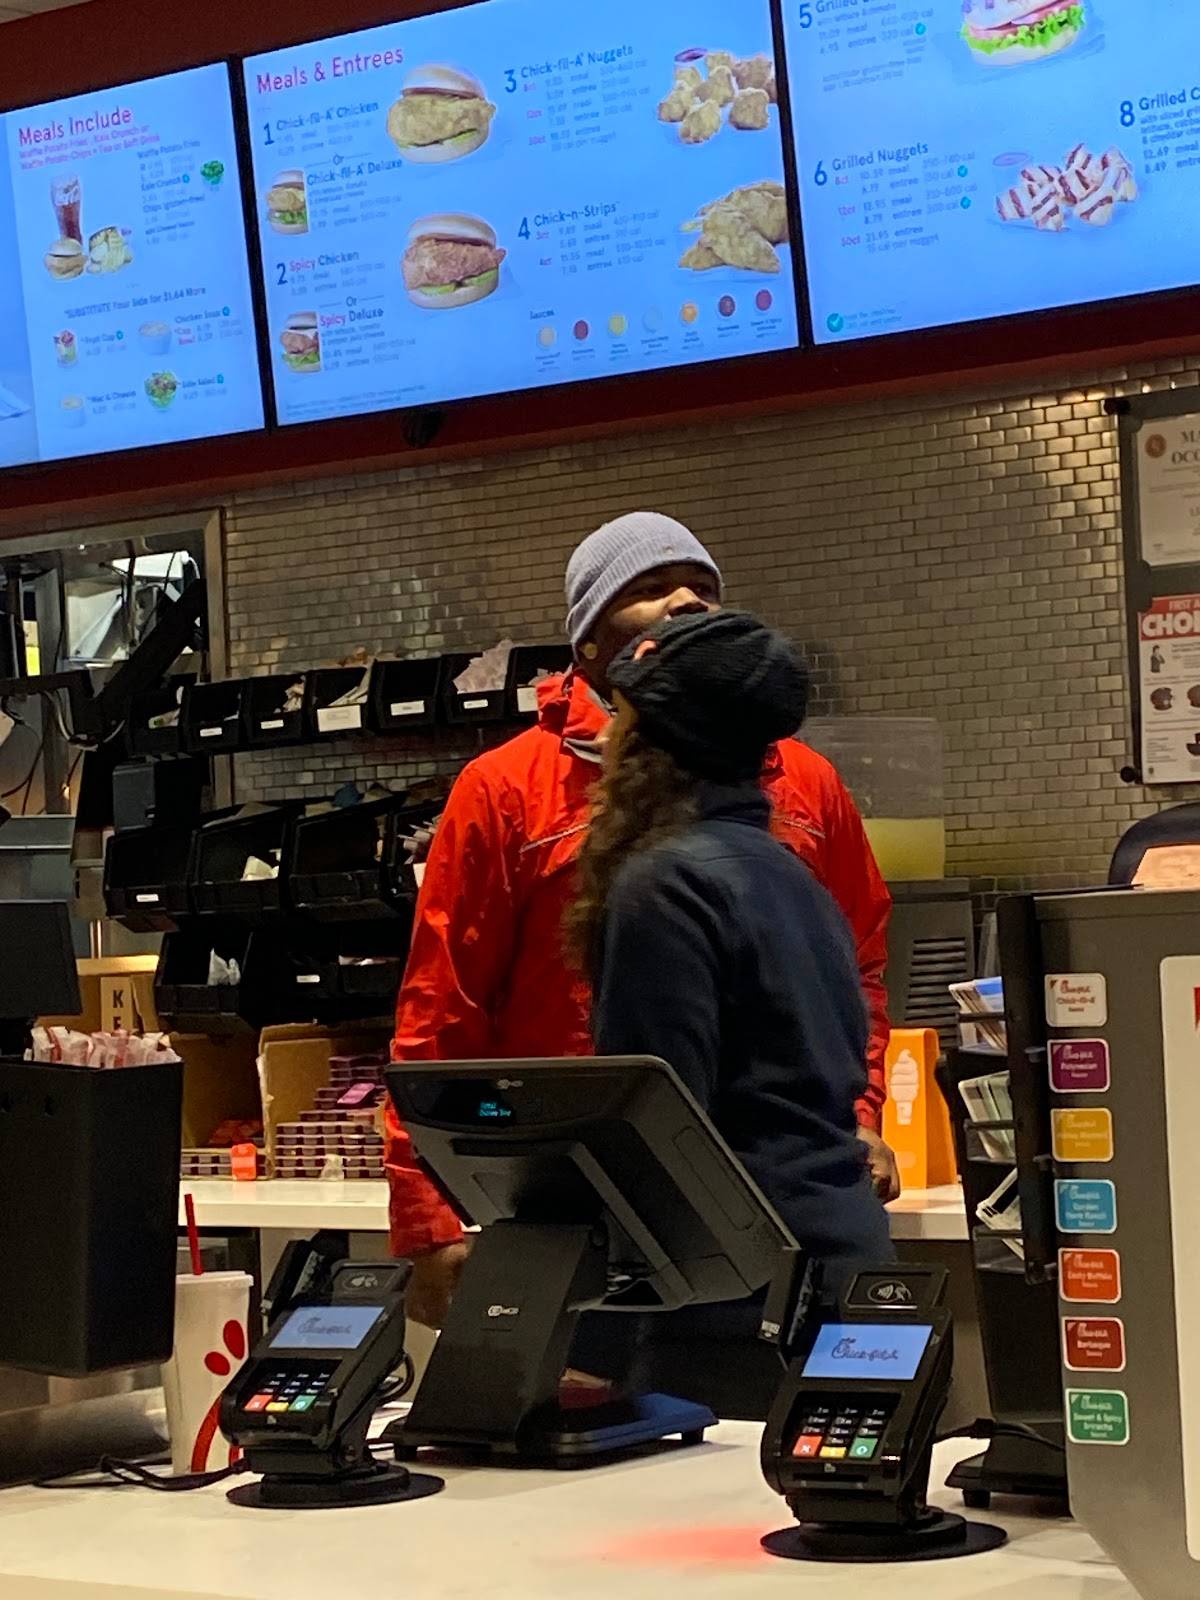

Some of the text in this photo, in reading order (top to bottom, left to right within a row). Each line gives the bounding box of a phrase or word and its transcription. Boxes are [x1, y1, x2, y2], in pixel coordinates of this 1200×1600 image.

[799, 3, 812, 29] 5
[257, 48, 404, 94] Meals & Entrees
[504, 69, 517, 93] 3
[588, 45, 633, 64] Nuggets
[1120, 100, 1135, 127] 8
[1139, 89, 1187, 110] Grilled
[18, 105, 132, 146] Meals Include
[263, 122, 275, 146] 1
[814, 142, 928, 186] 6 Grilled Nuggets
[518, 217, 531, 240] 4
[276, 263, 289, 285] 2
[289, 258, 316, 273] Spicy
[318, 250, 360, 267] Chicken
[346, 296, 358, 307] Or
[320, 308, 384, 328] Spicy Deluxe
[113, 989, 124, 1008] K
